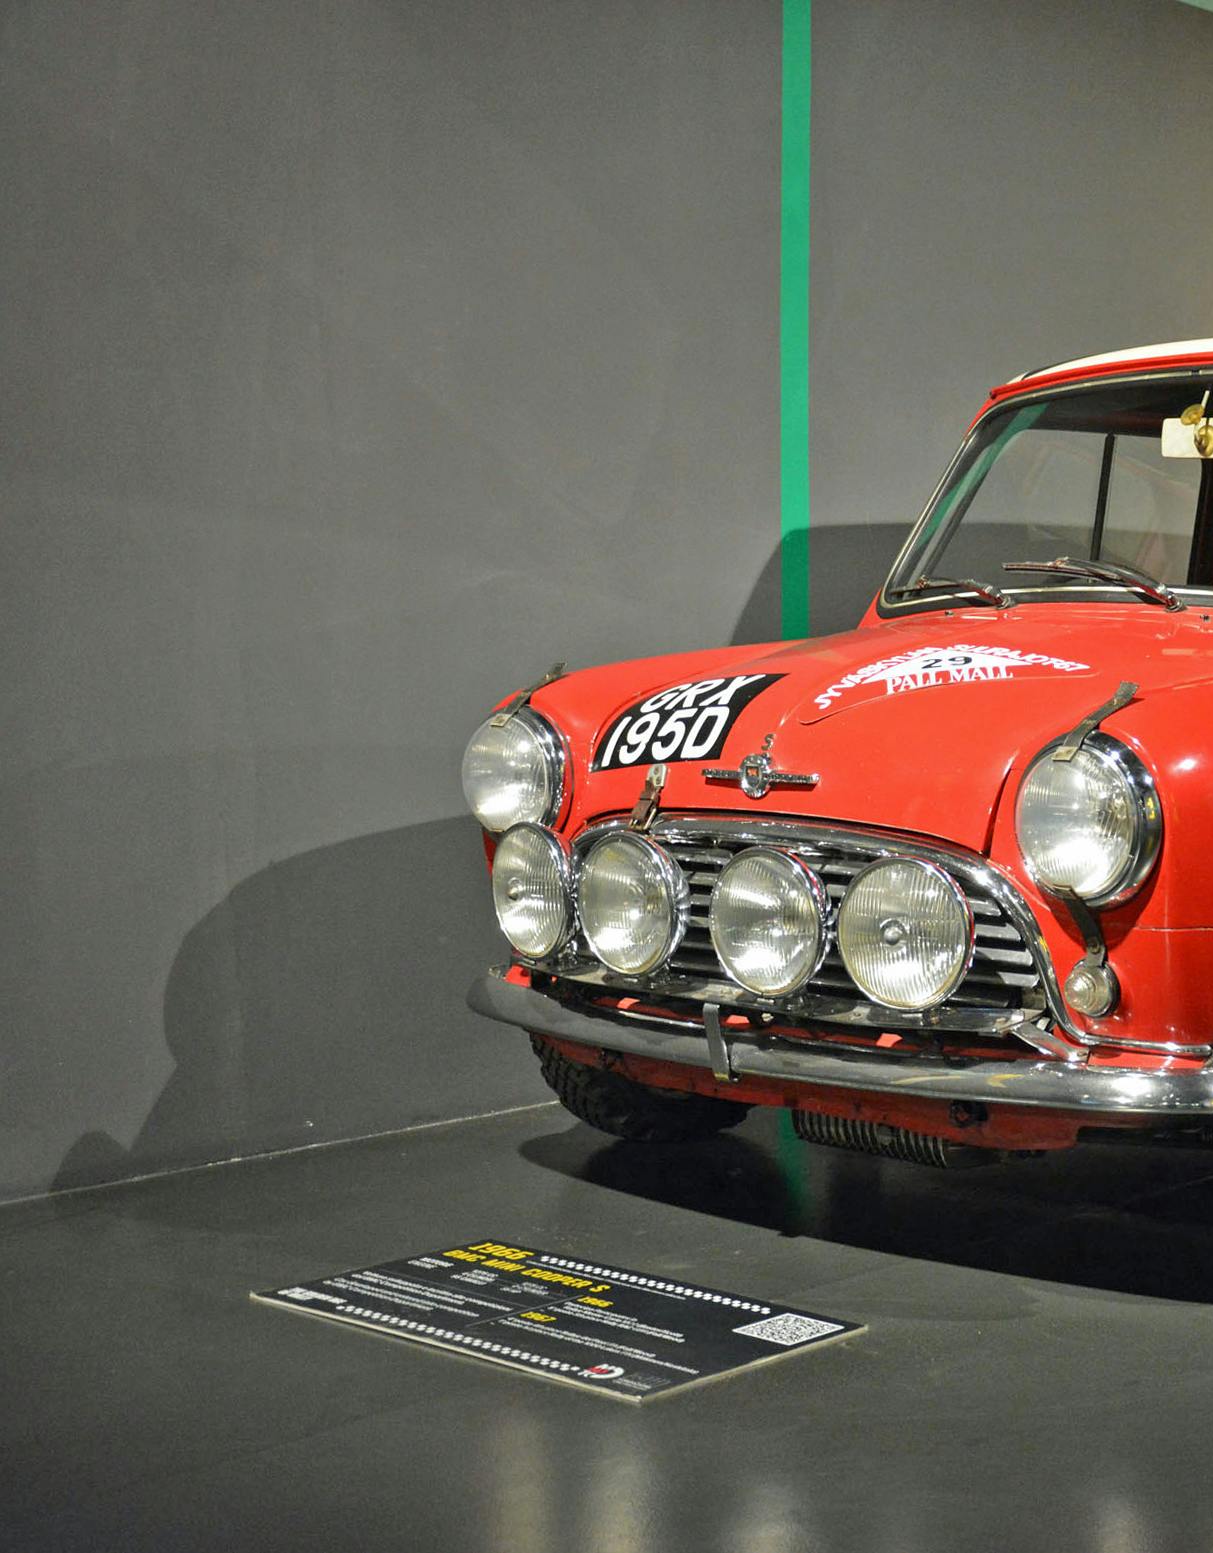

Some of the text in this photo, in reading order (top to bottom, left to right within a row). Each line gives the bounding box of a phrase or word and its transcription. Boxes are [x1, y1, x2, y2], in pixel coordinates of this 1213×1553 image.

[921, 655, 973, 669] 29
[640, 674, 767, 714] GRX
[886, 665, 1013, 695] PALL MALL
[601, 705, 730, 768] 195D
[468, 1242, 535, 1261] 1966
[442, 1249, 487, 1263] BMC
[480, 1258, 527, 1272] MINI
[520, 1267, 593, 1289] COOPER
[589, 1284, 611, 1293] S
